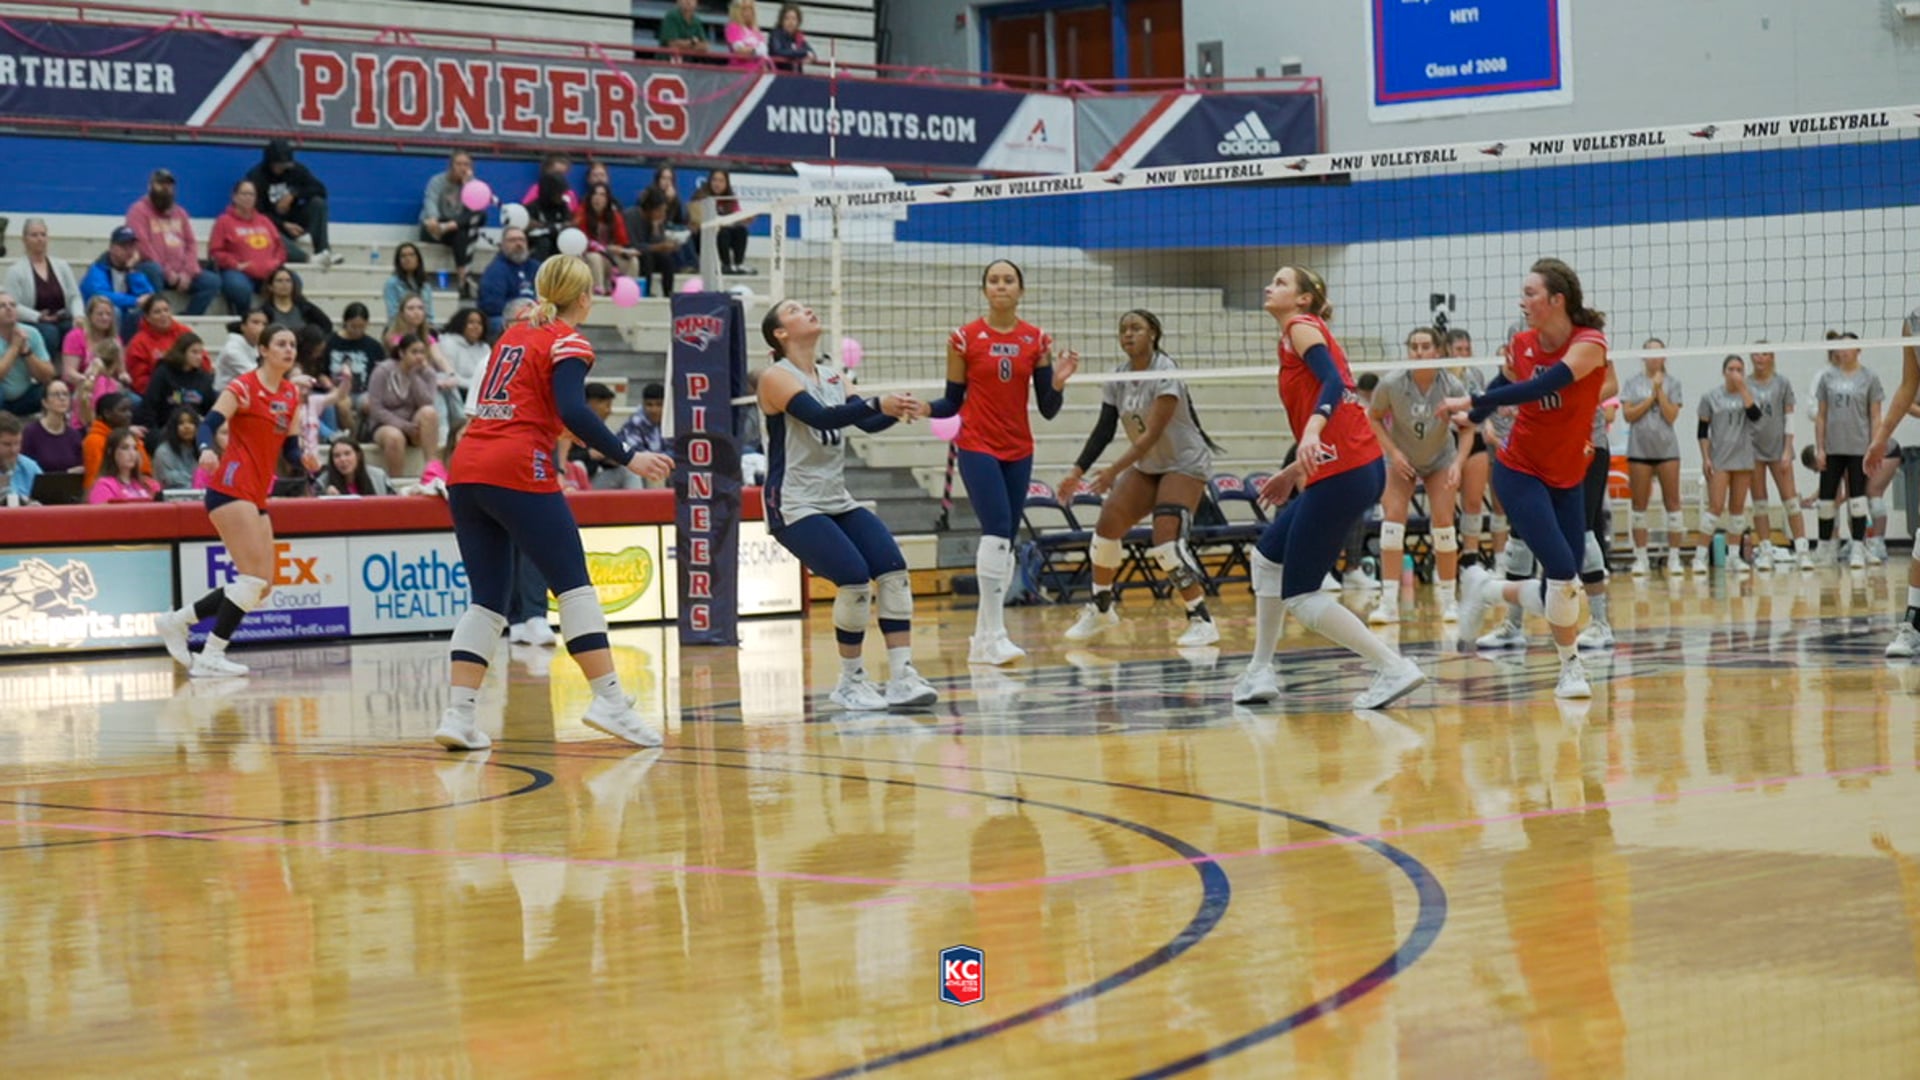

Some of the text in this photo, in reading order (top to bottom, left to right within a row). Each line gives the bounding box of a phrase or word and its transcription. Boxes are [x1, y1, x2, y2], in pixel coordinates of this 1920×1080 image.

[1450, 8, 1479, 24] HEY!
[1425, 57, 1508, 78] Class of 2008
[295, 49, 690, 146] PIONEERS
[766, 105, 977, 143] MNUSPORTS.COM
[1743, 112, 1889, 138] MNU VOLLEYBALL
[1217, 138, 1281, 156] adidas
[1529, 131, 1666, 155] MNU VOLLEYBALL
[1330, 149, 1458, 170] MNU VOLLEYBALL
[1146, 164, 1264, 184] MNU VOLLEYBALL
[847, 190, 916, 206] VOLLEYBALL
[974, 178, 1084, 198] MNU VOLLEYBALL
[484, 344, 526, 402] 12
[998, 357, 1012, 383] 8
[1414, 421, 1426, 440] 9
[685, 373, 713, 631] PIONEERS
[363, 550, 468, 593] Olathe
[272, 591, 321, 607] Ground
[375, 591, 468, 620] HEALTH
[263, 613, 292, 625] Hiring
